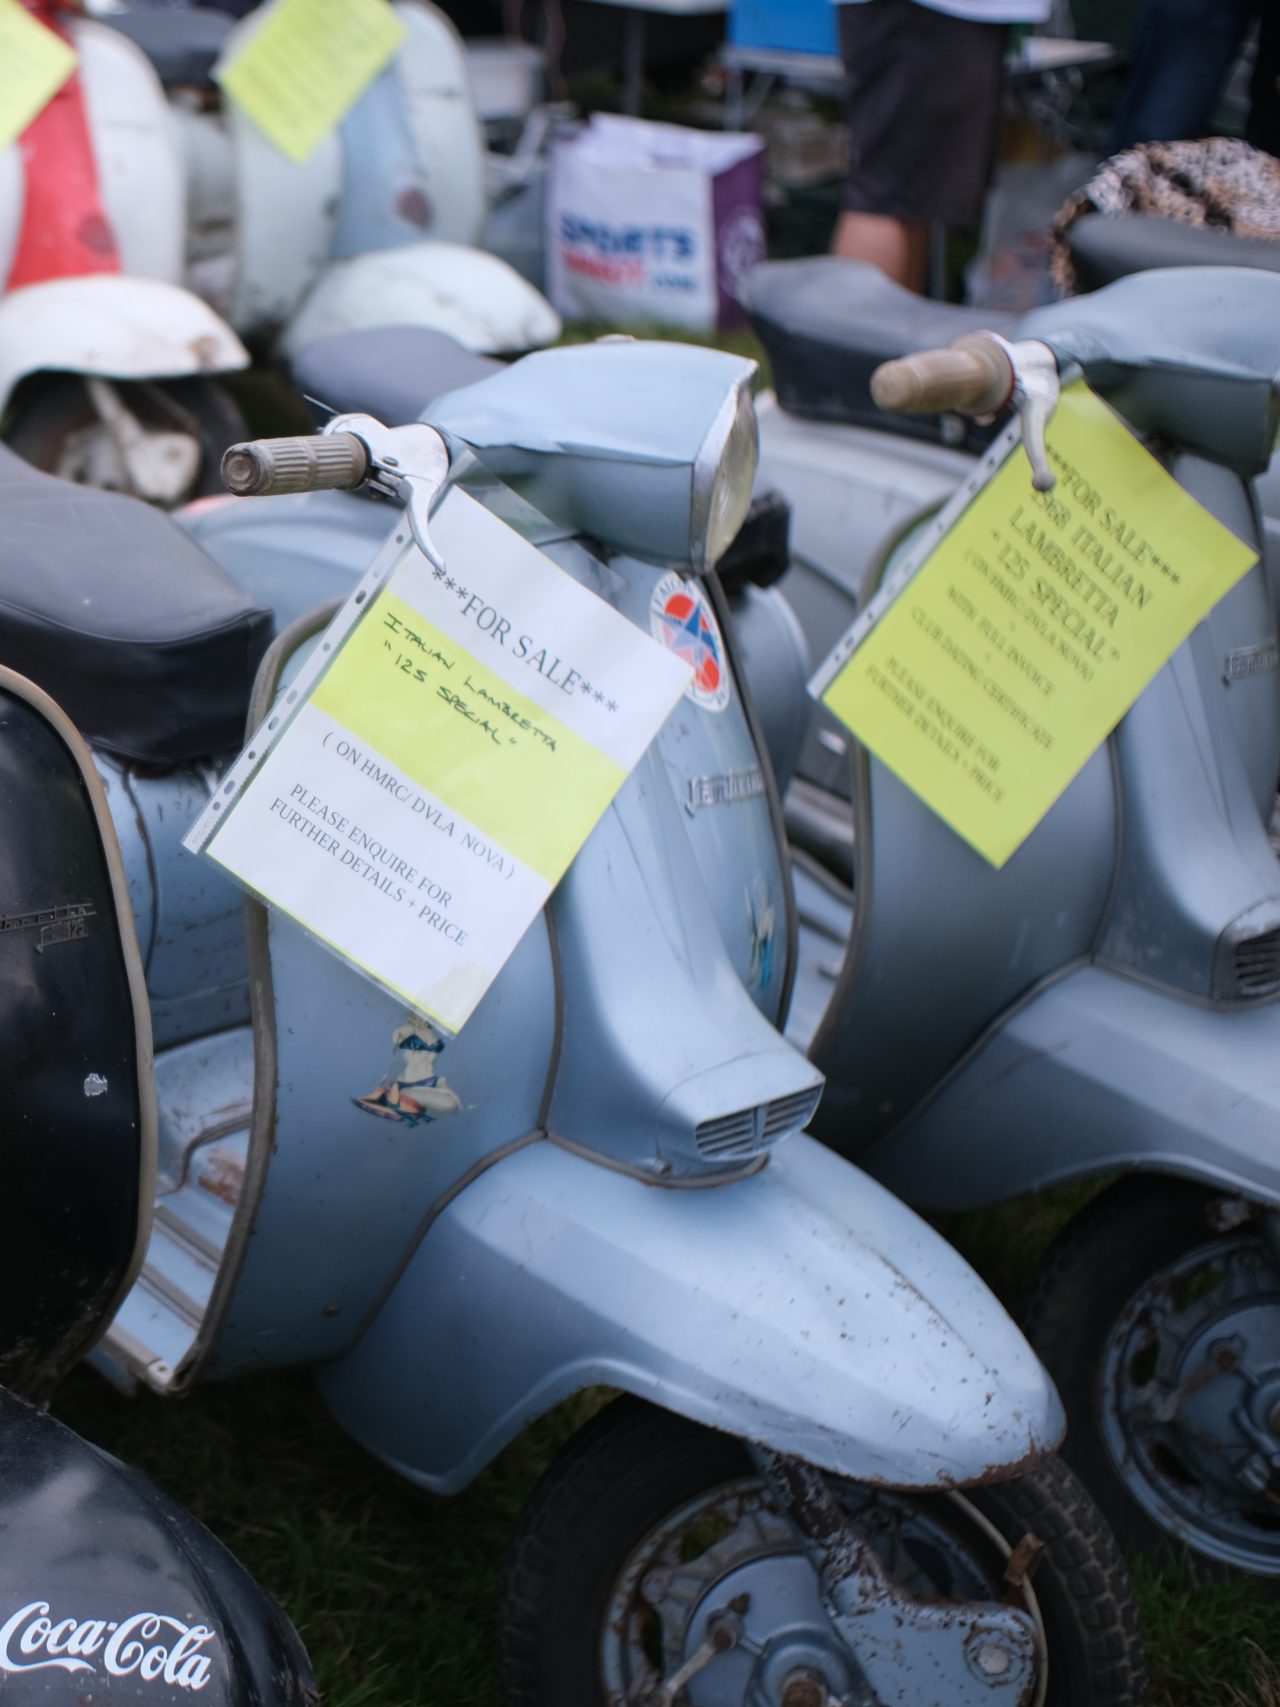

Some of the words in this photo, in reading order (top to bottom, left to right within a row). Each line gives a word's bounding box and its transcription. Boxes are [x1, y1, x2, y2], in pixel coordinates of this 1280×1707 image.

[384, 612, 455, 670] ITALIAN
[463, 676, 556, 752] LAMBRETTA
[270, 797, 340, 856] FURTHER
[339, 849, 406, 902] DETAILS
[418, 905, 467, 946] PRICE
[290, 783, 349, 833] PLEASE
[347, 826, 417, 883] ENQUIRE
[418, 876, 452, 908] FOR
[336, 741, 362, 765] ON
[411, 796, 455, 837] DVLA
[460, 832, 504, 872] NOVA
